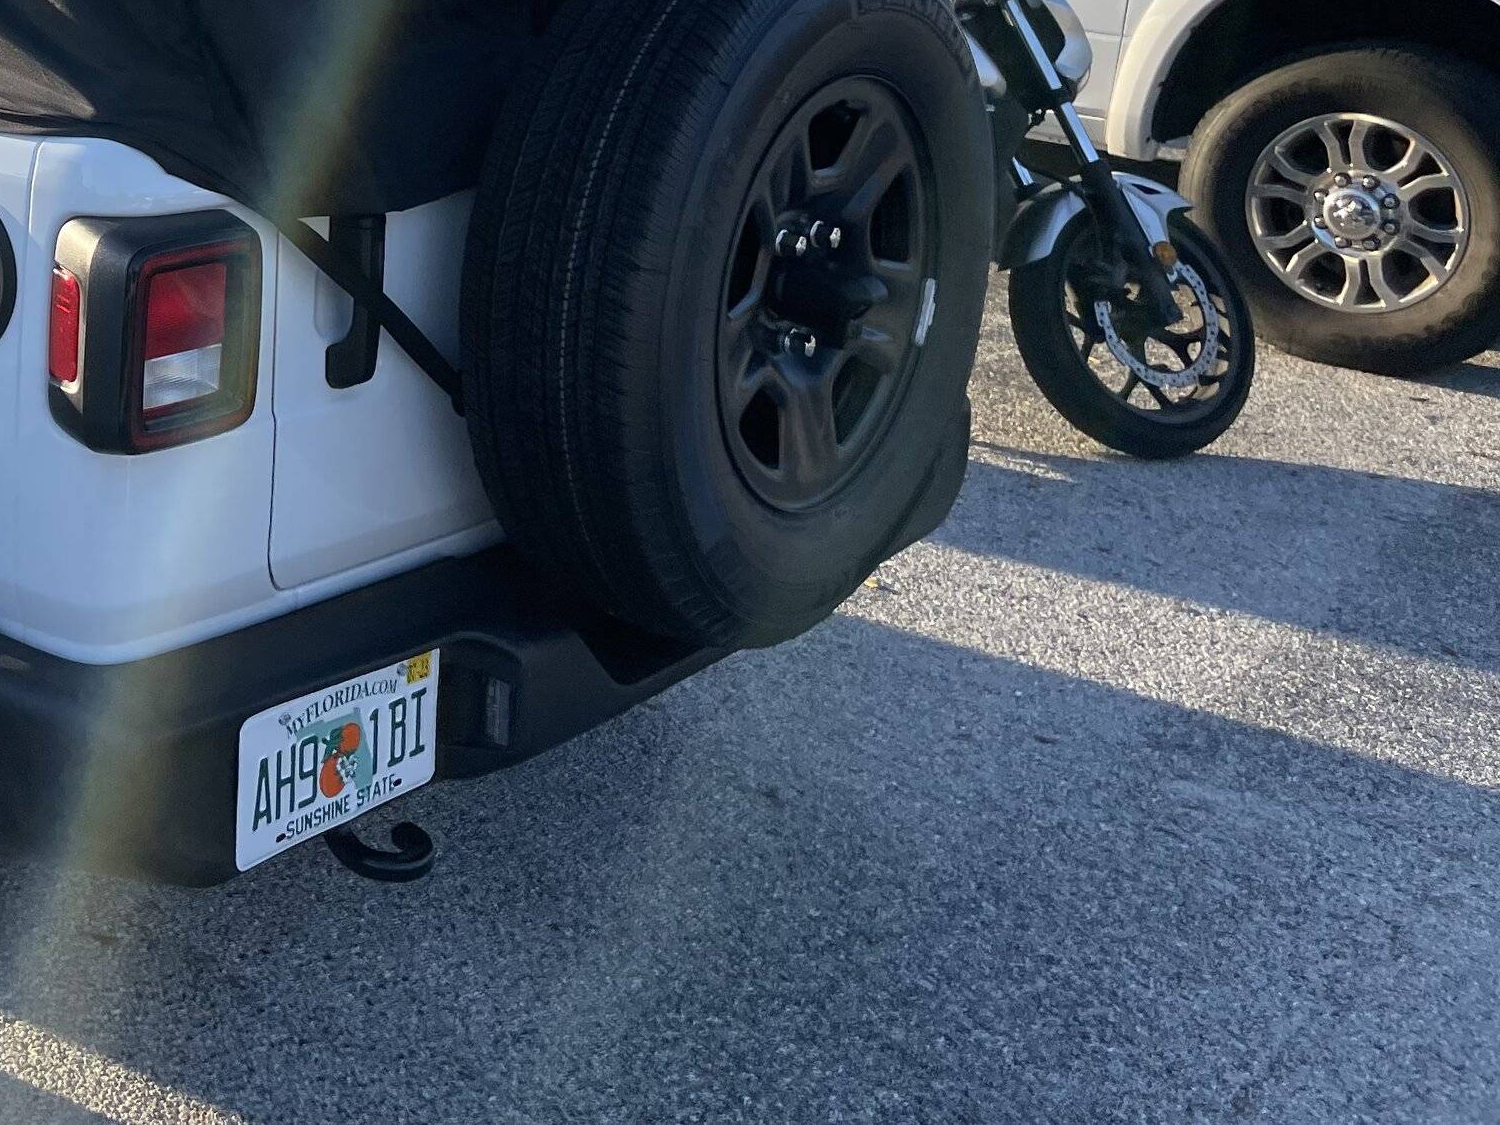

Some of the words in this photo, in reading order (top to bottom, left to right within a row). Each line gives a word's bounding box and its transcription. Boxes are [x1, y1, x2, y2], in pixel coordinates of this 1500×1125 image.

[252, 735, 318, 832] AH9
[286, 797, 350, 839] SUNSHINE
[356, 774, 396, 807] STATE
